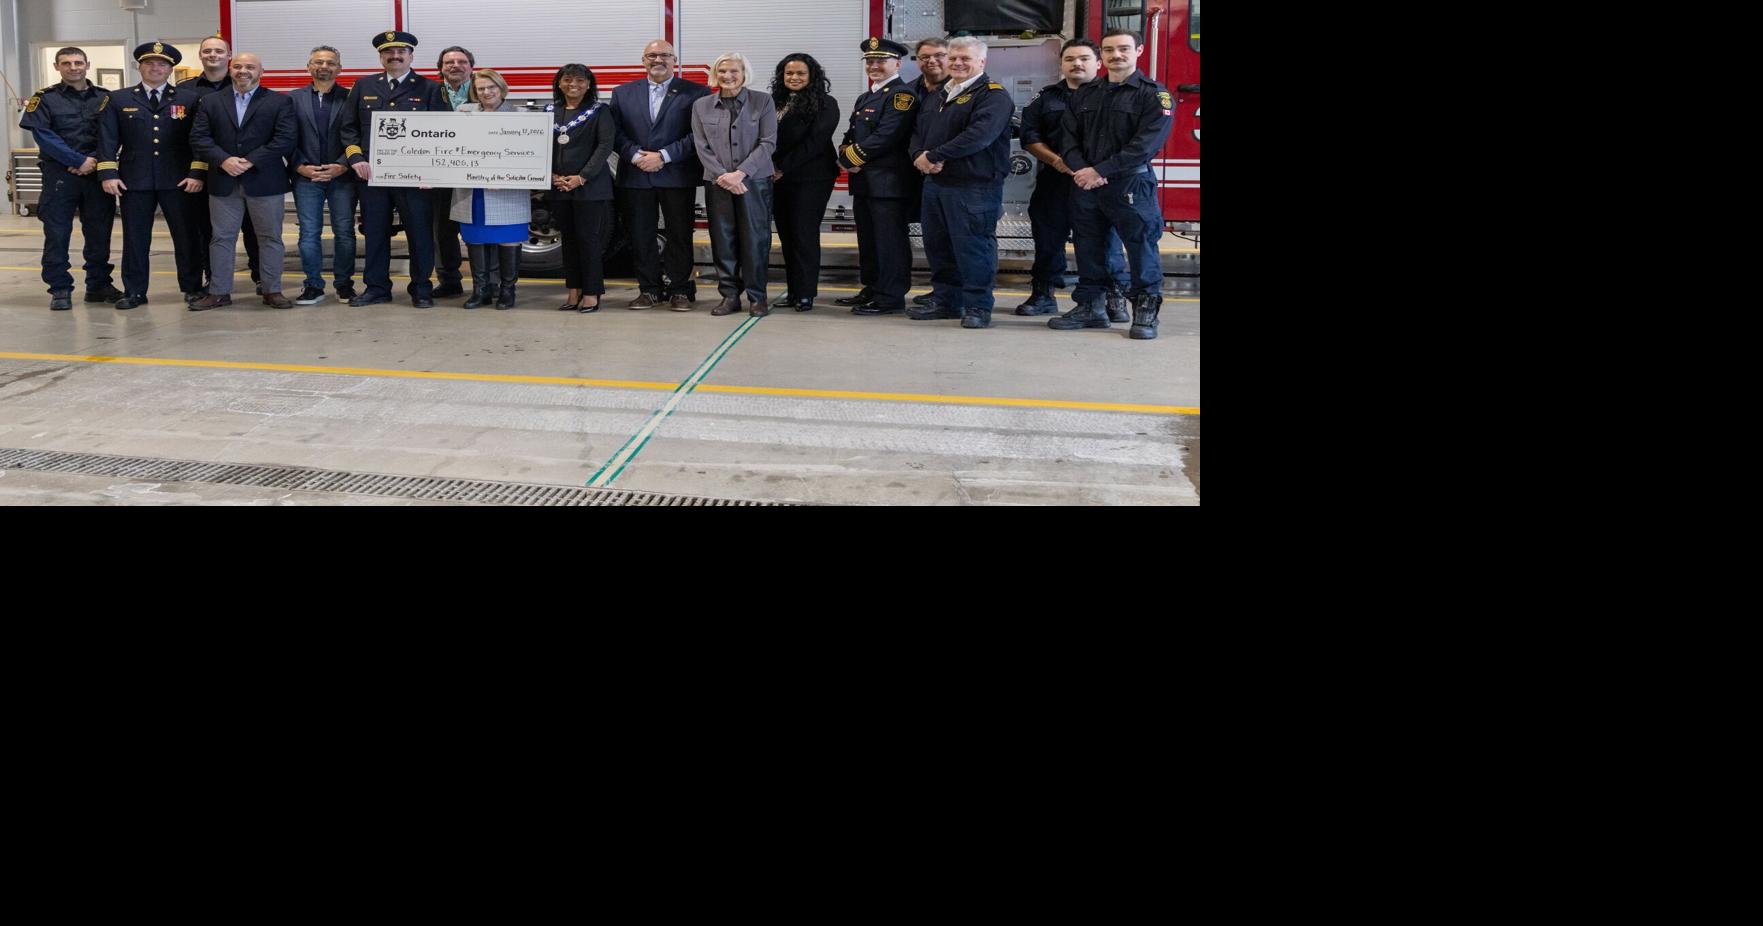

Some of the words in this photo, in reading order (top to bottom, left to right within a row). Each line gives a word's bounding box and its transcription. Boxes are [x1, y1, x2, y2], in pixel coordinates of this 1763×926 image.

[411, 129, 456, 138] Ontario
[435, 146, 453, 156] Fire
[461, 146, 502, 159] Emergency
[504, 148, 535, 156] Services
[384, 172, 397, 180] Fire
[398, 172, 421, 181] Safety
